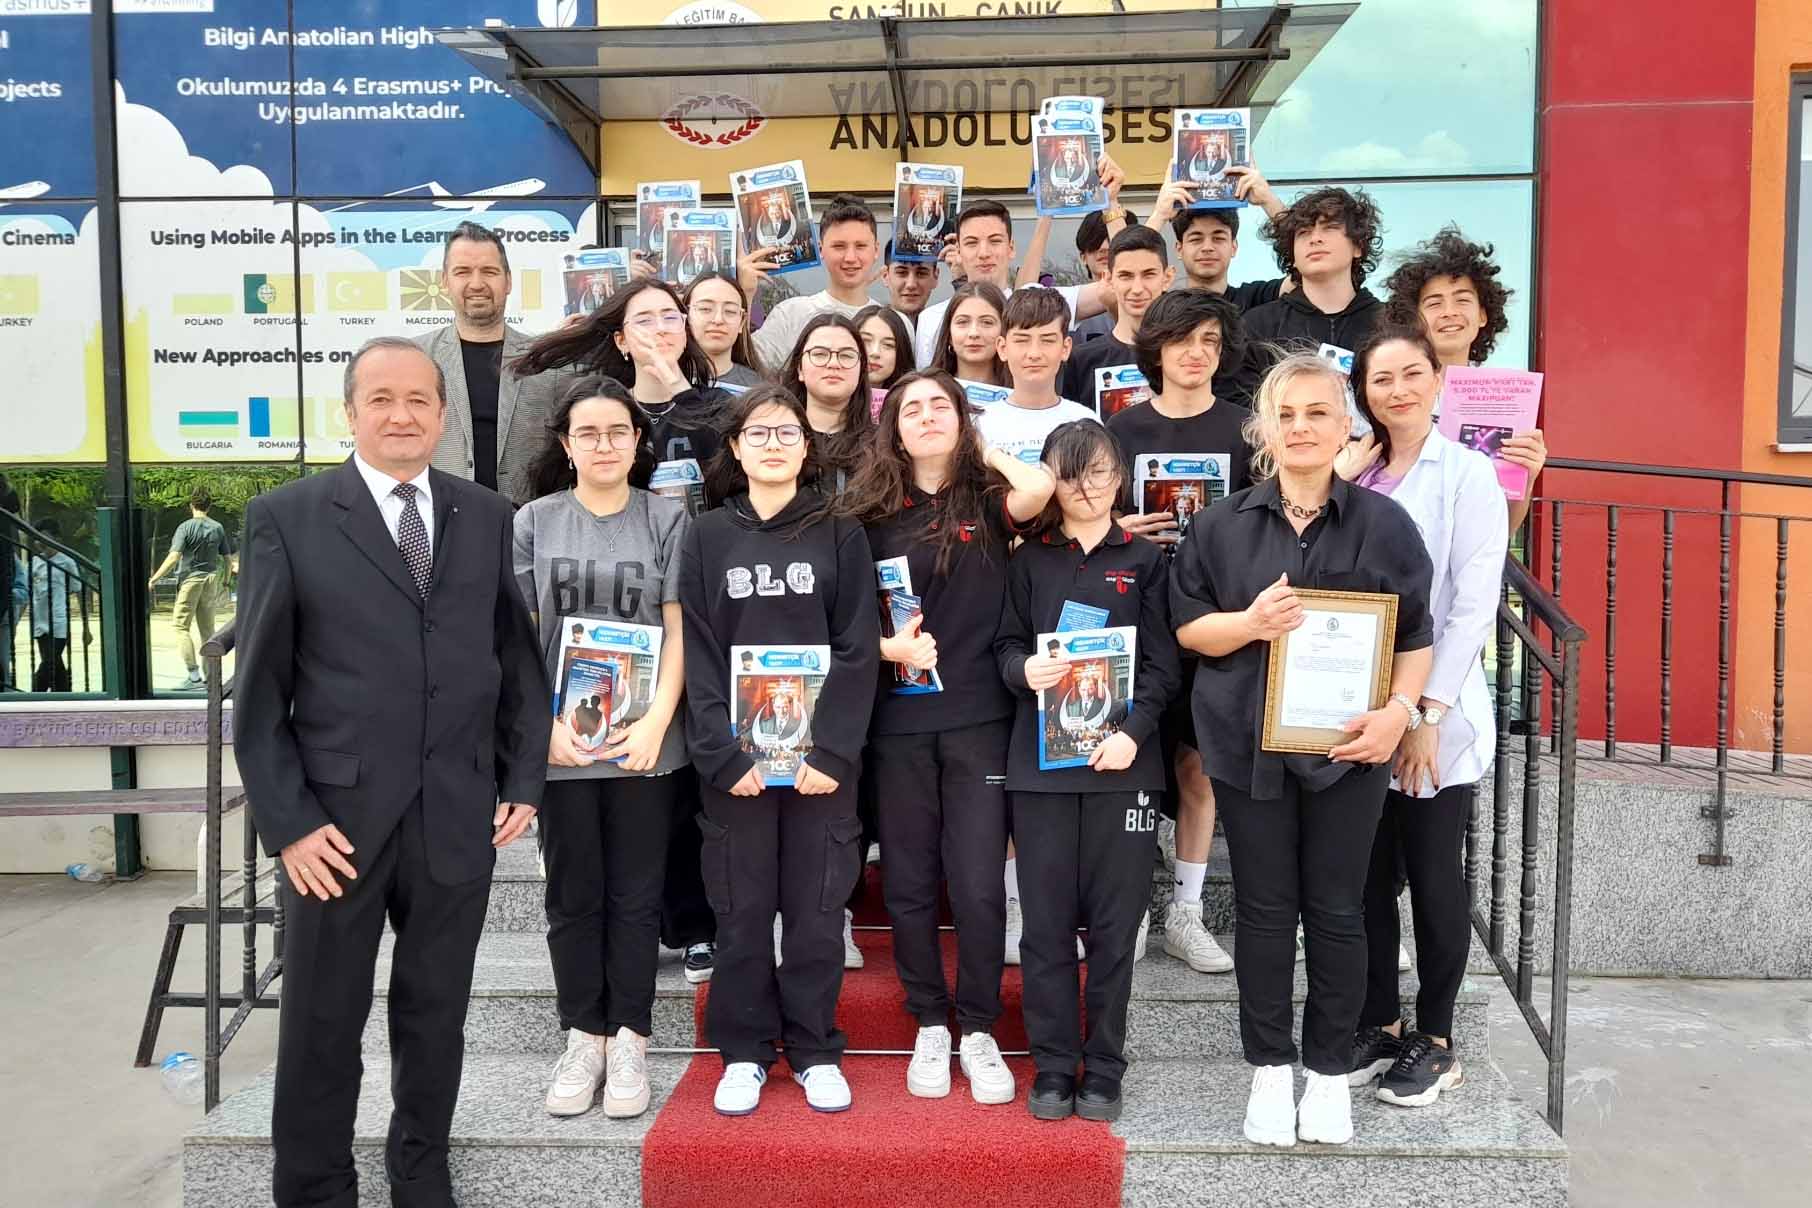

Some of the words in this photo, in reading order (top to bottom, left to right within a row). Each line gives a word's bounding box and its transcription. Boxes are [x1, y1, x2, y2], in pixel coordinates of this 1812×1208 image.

[204, 27, 255, 49] Bilgi
[261, 27, 374, 46] Anatolian
[381, 27, 434, 49] High
[177, 77, 326, 96] Okulumuzda
[333, 78, 348, 95] 4
[354, 77, 463, 95] Erasmus+
[259, 100, 465, 124] Uygulanmaktadır.
[830, 110, 1033, 150] ANADOLU
[2, 229, 75, 246] Cinema
[151, 230, 206, 248] Using
[211, 229, 275, 245] Mobile
[280, 228, 336, 248] Apps
[341, 227, 358, 244] in
[364, 228, 394, 244] the
[184, 317, 223, 326] POLAND
[253, 317, 309, 326] PORTUGAL
[339, 317, 376, 326] TURKEY
[153, 348, 197, 364] New
[202, 347, 324, 367] Approaches
[329, 350, 353, 363] on
[186, 441, 233, 449] BULGARIA
[258, 440, 308, 449] ROMANIA
[552, 557, 645, 618] BLG
[726, 562, 816, 600] BLG
[1125, 808, 1155, 832] BLG
